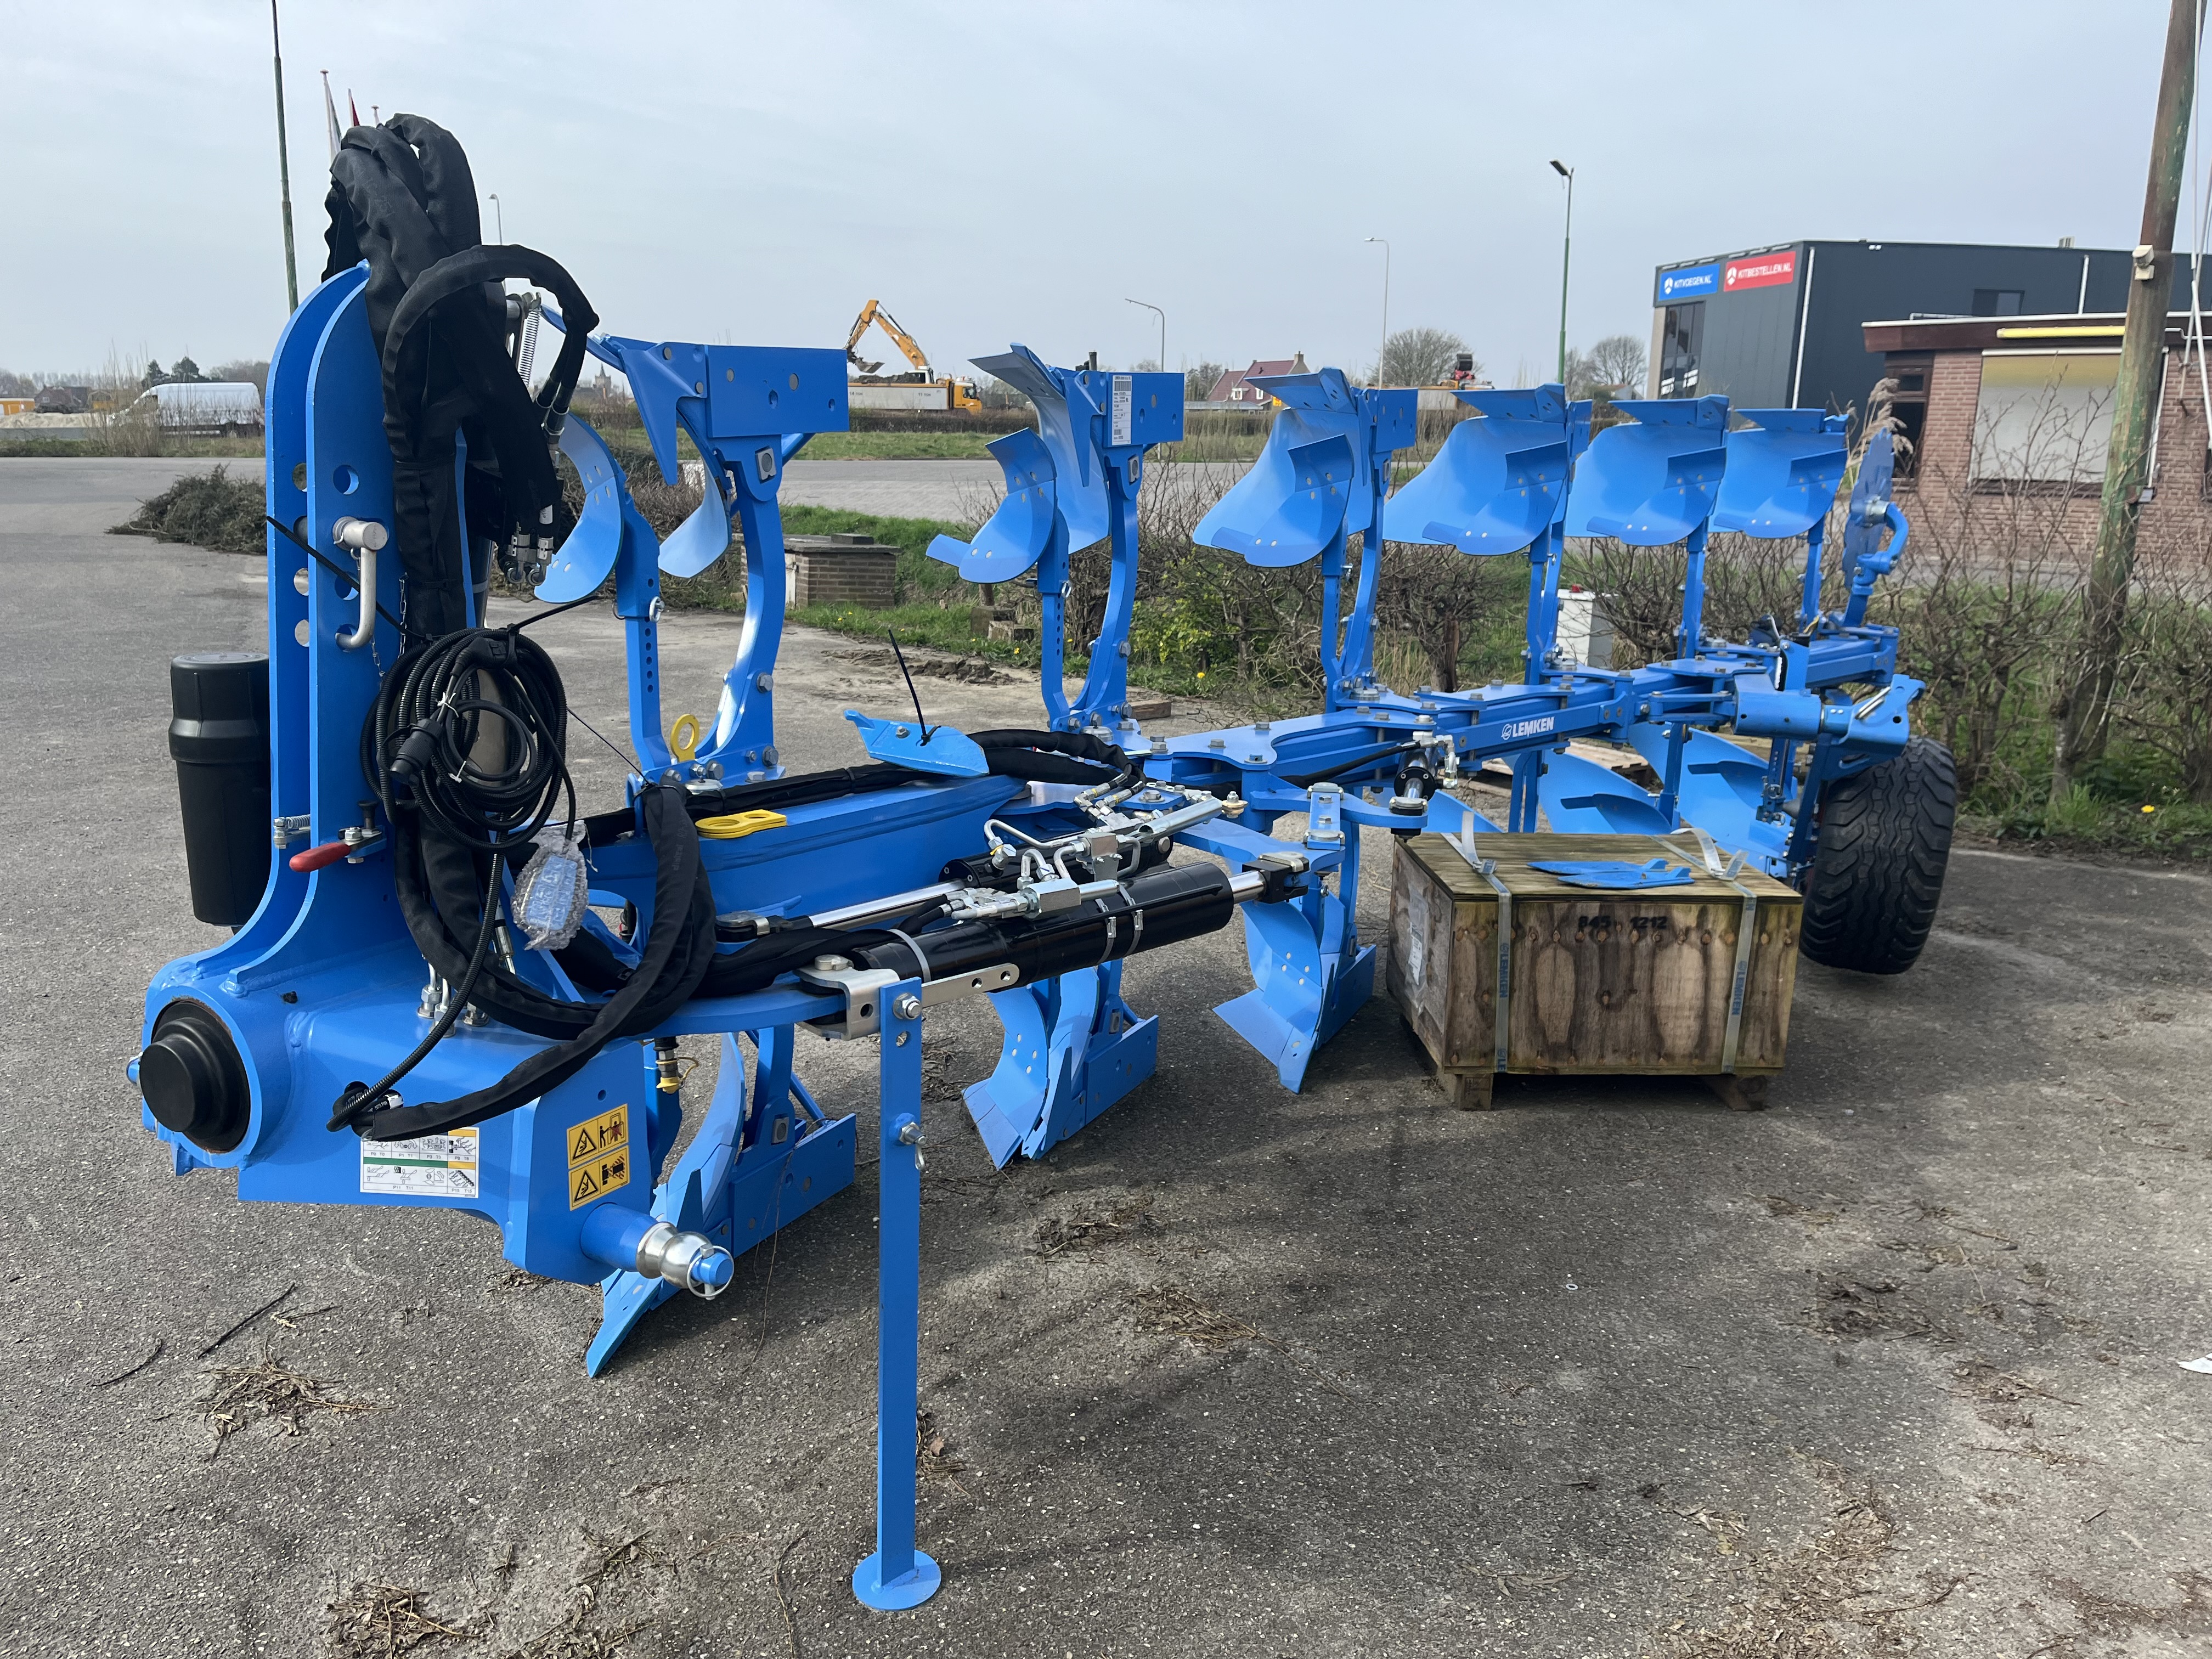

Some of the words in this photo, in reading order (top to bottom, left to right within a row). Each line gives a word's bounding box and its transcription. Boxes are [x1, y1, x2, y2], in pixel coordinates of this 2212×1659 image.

[1737, 262, 1792, 279] KITBESTELLEN.NL
[1674, 275, 1712, 289] KITVOEGEN.NL
[1513, 716, 1555, 737] LEMKEN
[1630, 916, 1668, 929] 1212
[1499, 953, 1509, 998] LEMKEN
[1731, 972, 1746, 1015] LEMKEN
